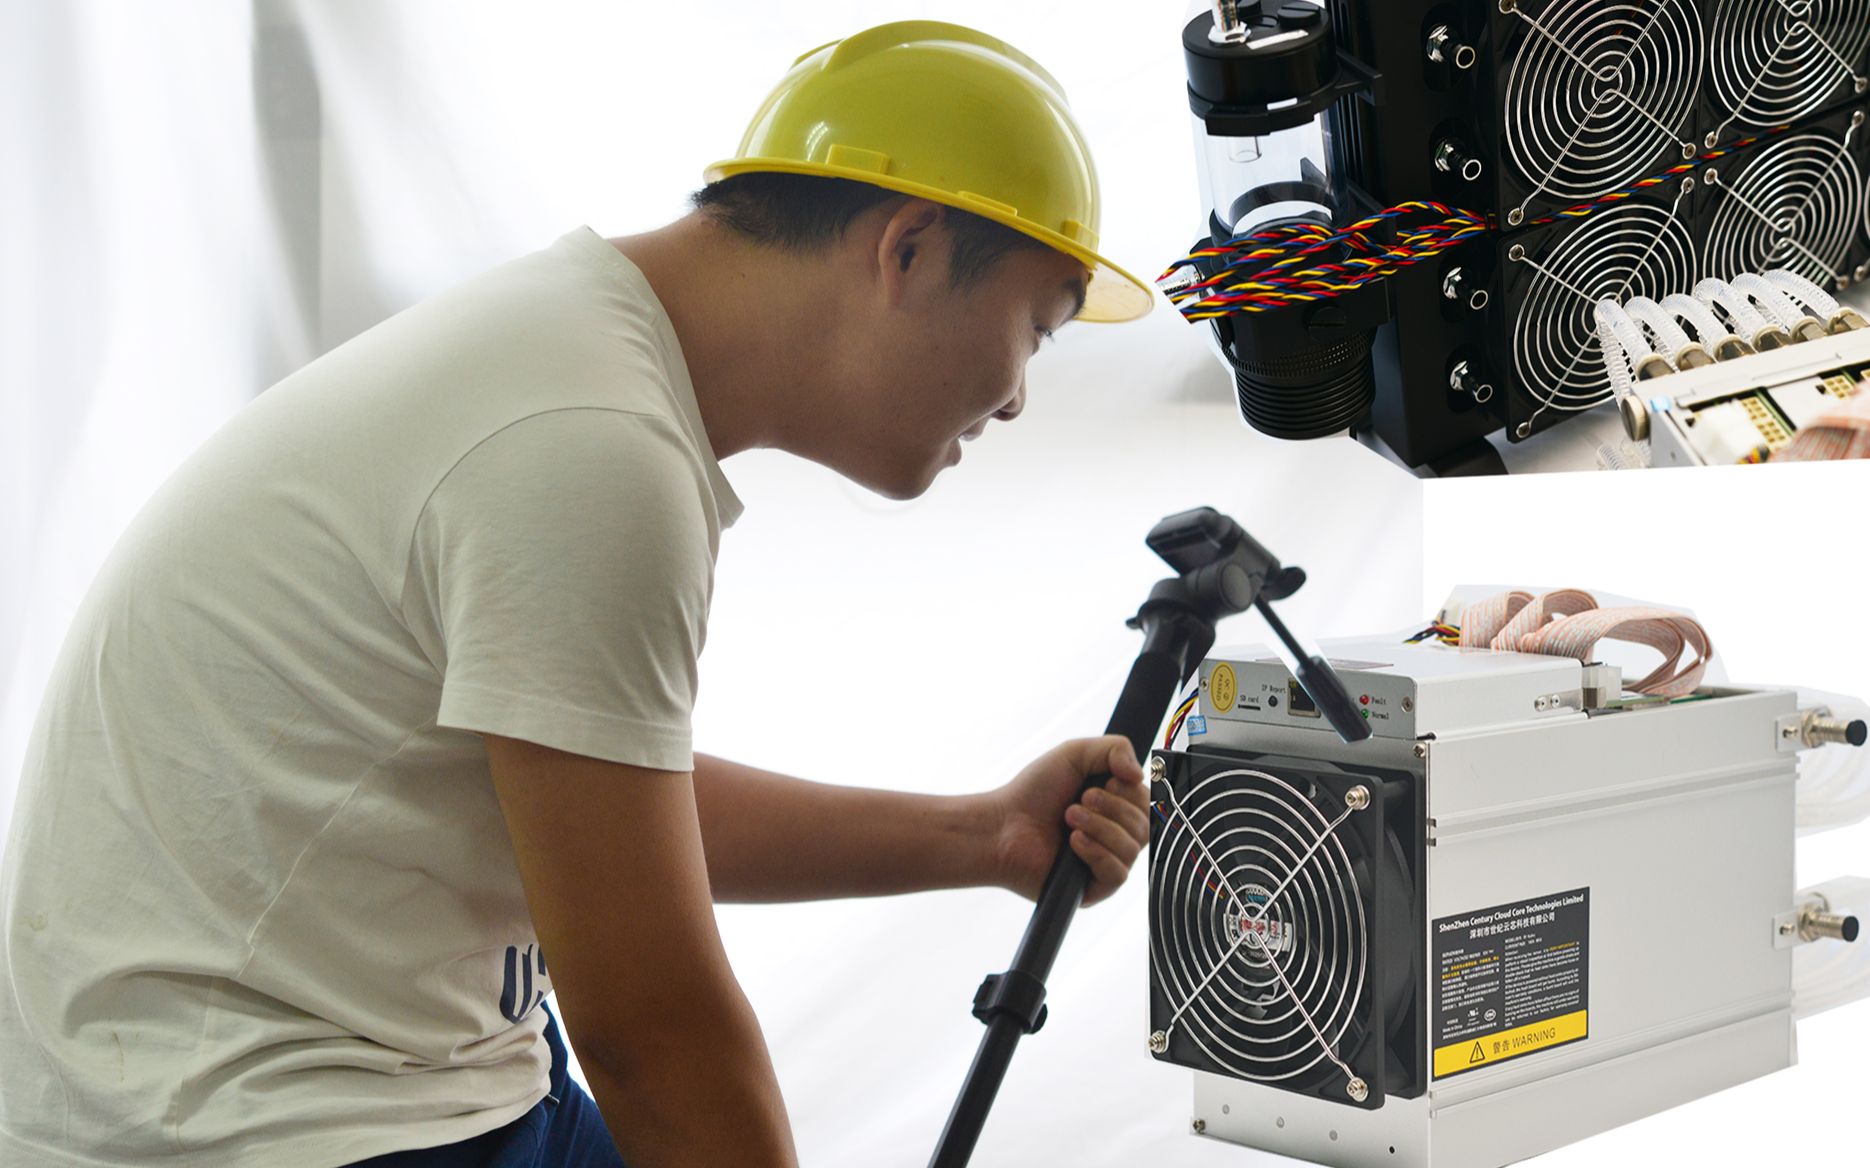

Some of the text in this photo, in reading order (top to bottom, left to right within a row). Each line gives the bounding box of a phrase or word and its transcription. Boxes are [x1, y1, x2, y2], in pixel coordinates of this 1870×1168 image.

[1269, 685, 1287, 694] Report
[1371, 697, 1387, 705] Fault
[1372, 711, 1389, 720] Normal
[1439, 894, 1584, 933] ShenZhen Century Cloud Core Technologies Limited
[1493, 1039, 1510, 1055] 警告
[1512, 1028, 1556, 1048] WARNING
